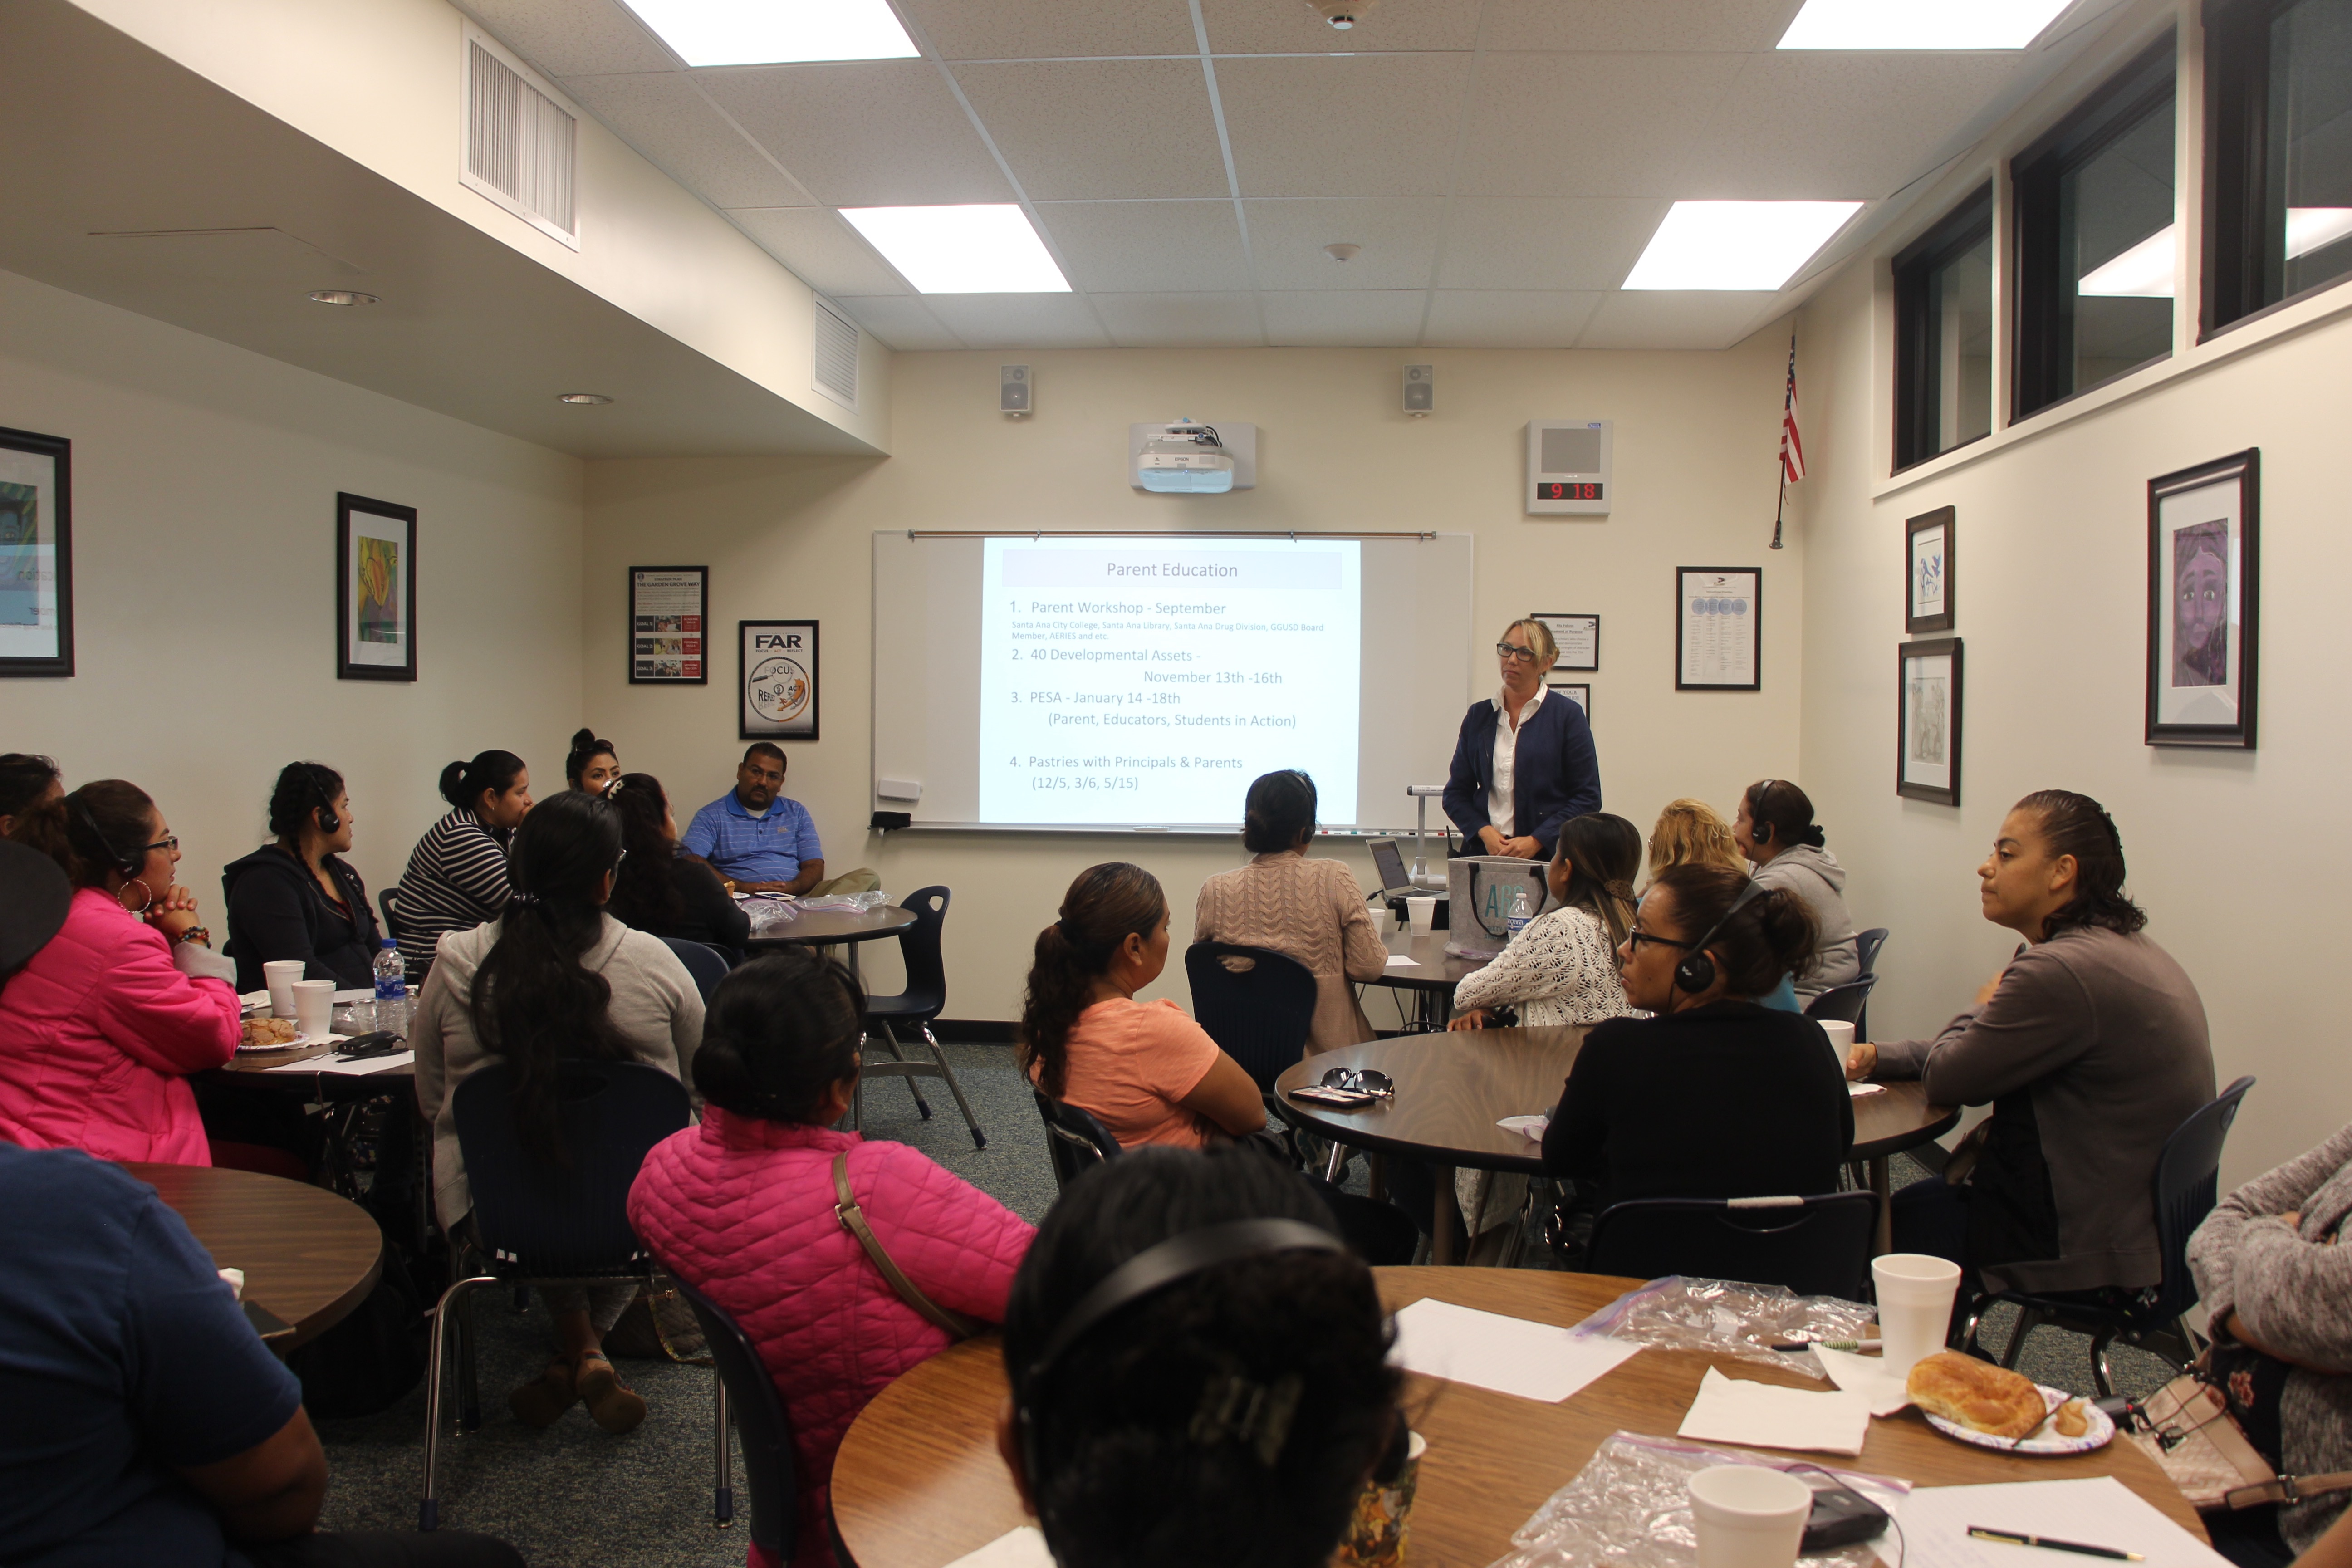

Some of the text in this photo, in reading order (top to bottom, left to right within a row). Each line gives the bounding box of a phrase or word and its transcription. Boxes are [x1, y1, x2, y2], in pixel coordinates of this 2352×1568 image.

[1551, 483, 1595, 499] 9 18
[1107, 562, 1238, 577] Parent Education
[1010, 601, 1021, 613] 1.
[1032, 601, 1074, 613] Parent
[1078, 601, 1143, 616] Workshop
[1155, 602, 1227, 617] September
[1012, 621, 1034, 629] Santa
[1053, 621, 1068, 630] City
[1069, 621, 1100, 630] College,
[1143, 622, 1172, 631] Library,
[1215, 622, 1234, 632] Drug
[1235, 623, 1268, 632] Division,
[1270, 623, 1299, 631] GGUSD
[1301, 623, 1324, 632] Board
[755, 635, 802, 648] FAR
[1012, 632, 1047, 641] Member,
[1012, 648, 1023, 660] 2.
[1030, 648, 1047, 660] 40
[1051, 648, 1147, 663] Developmental
[1151, 649, 1192, 662] Assets
[764, 666, 795, 674] FOCUS
[1144, 671, 1212, 683] November
[1215, 671, 1244, 684] 13th
[1011, 691, 1022, 703] 3.
[1030, 691, 1062, 703] PESA
[1073, 691, 1124, 706] January
[1127, 692, 1143, 704] 14
[1049, 712, 1296, 729] (Parent, Educators, Students in Action)
[1009, 755, 1243, 770] 4. Pastries with Principals & Parents
[1032, 776, 1138, 791] (12/5, 3/6, 5/15)
